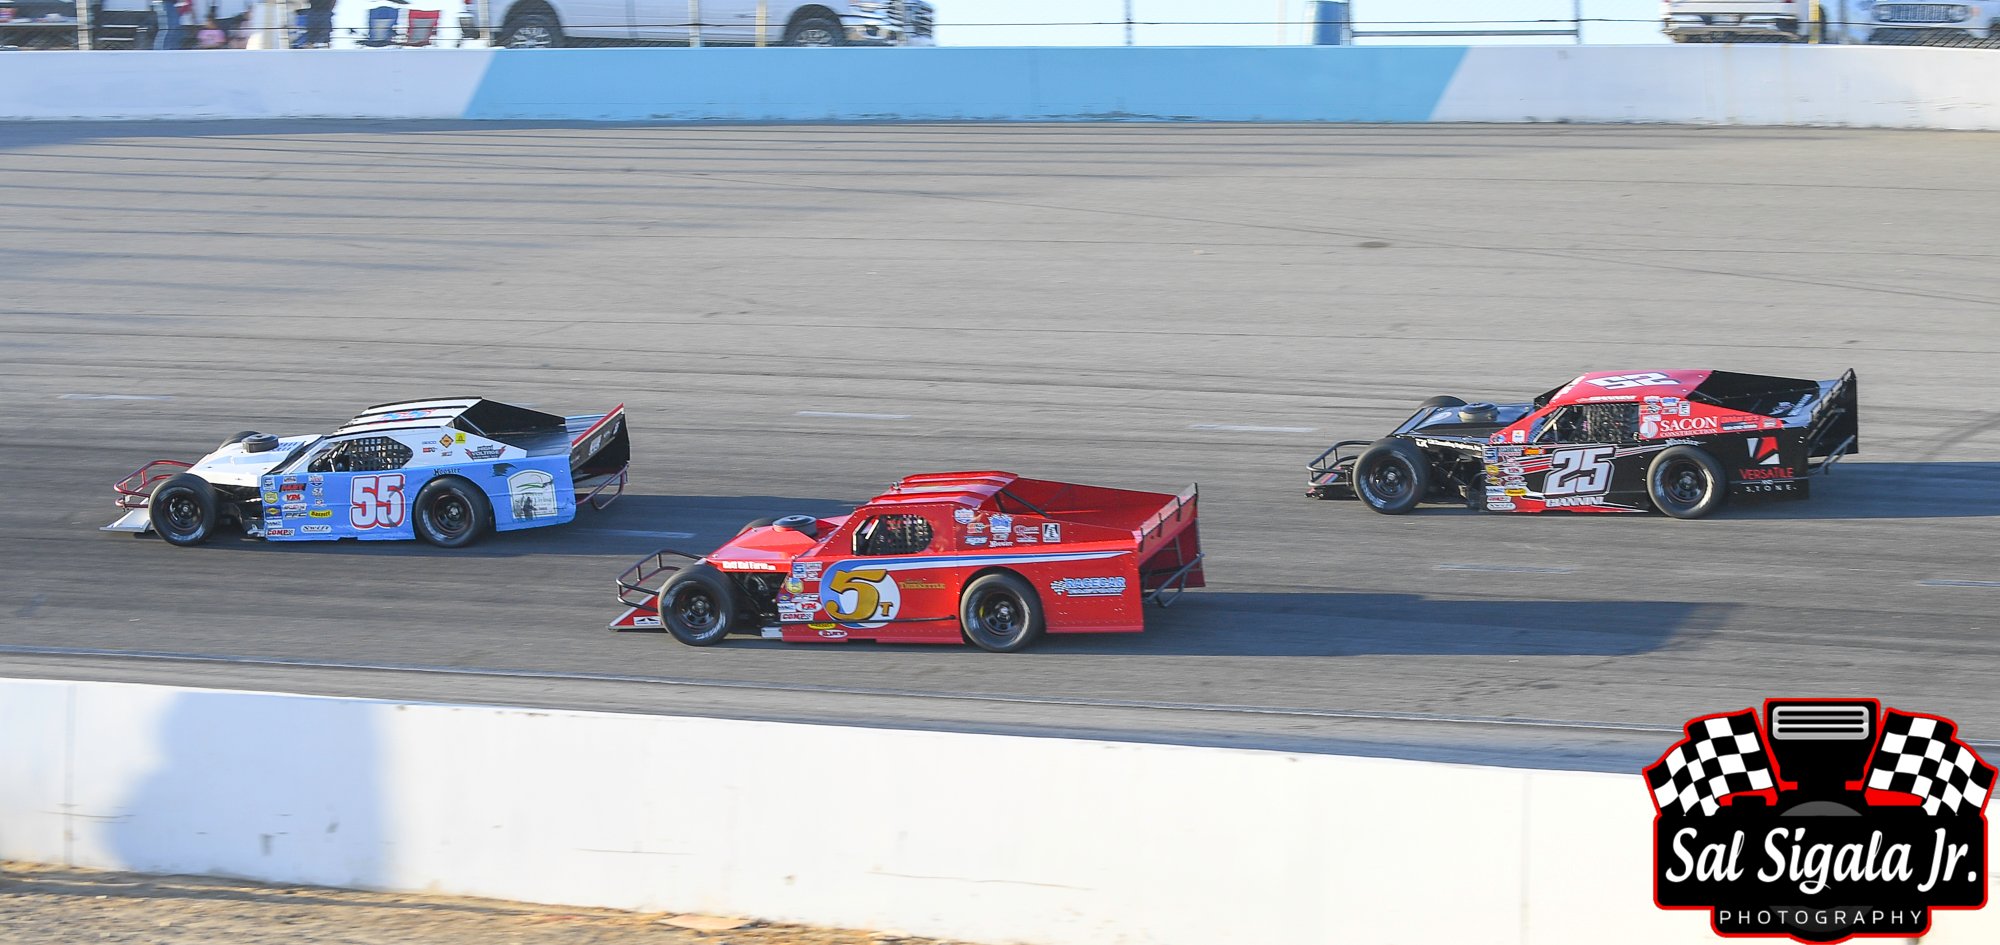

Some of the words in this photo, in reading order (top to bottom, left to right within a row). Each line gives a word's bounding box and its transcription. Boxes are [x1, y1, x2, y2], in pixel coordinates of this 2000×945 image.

[1660, 416, 1718, 431] SACON
[1545, 446, 1616, 496] 25
[1739, 467, 1793, 479] VERSATILE
[351, 474, 405, 529] 55
[1545, 497, 1604, 507] GIANNINI
[1063, 577, 1126, 588] RACECAR
